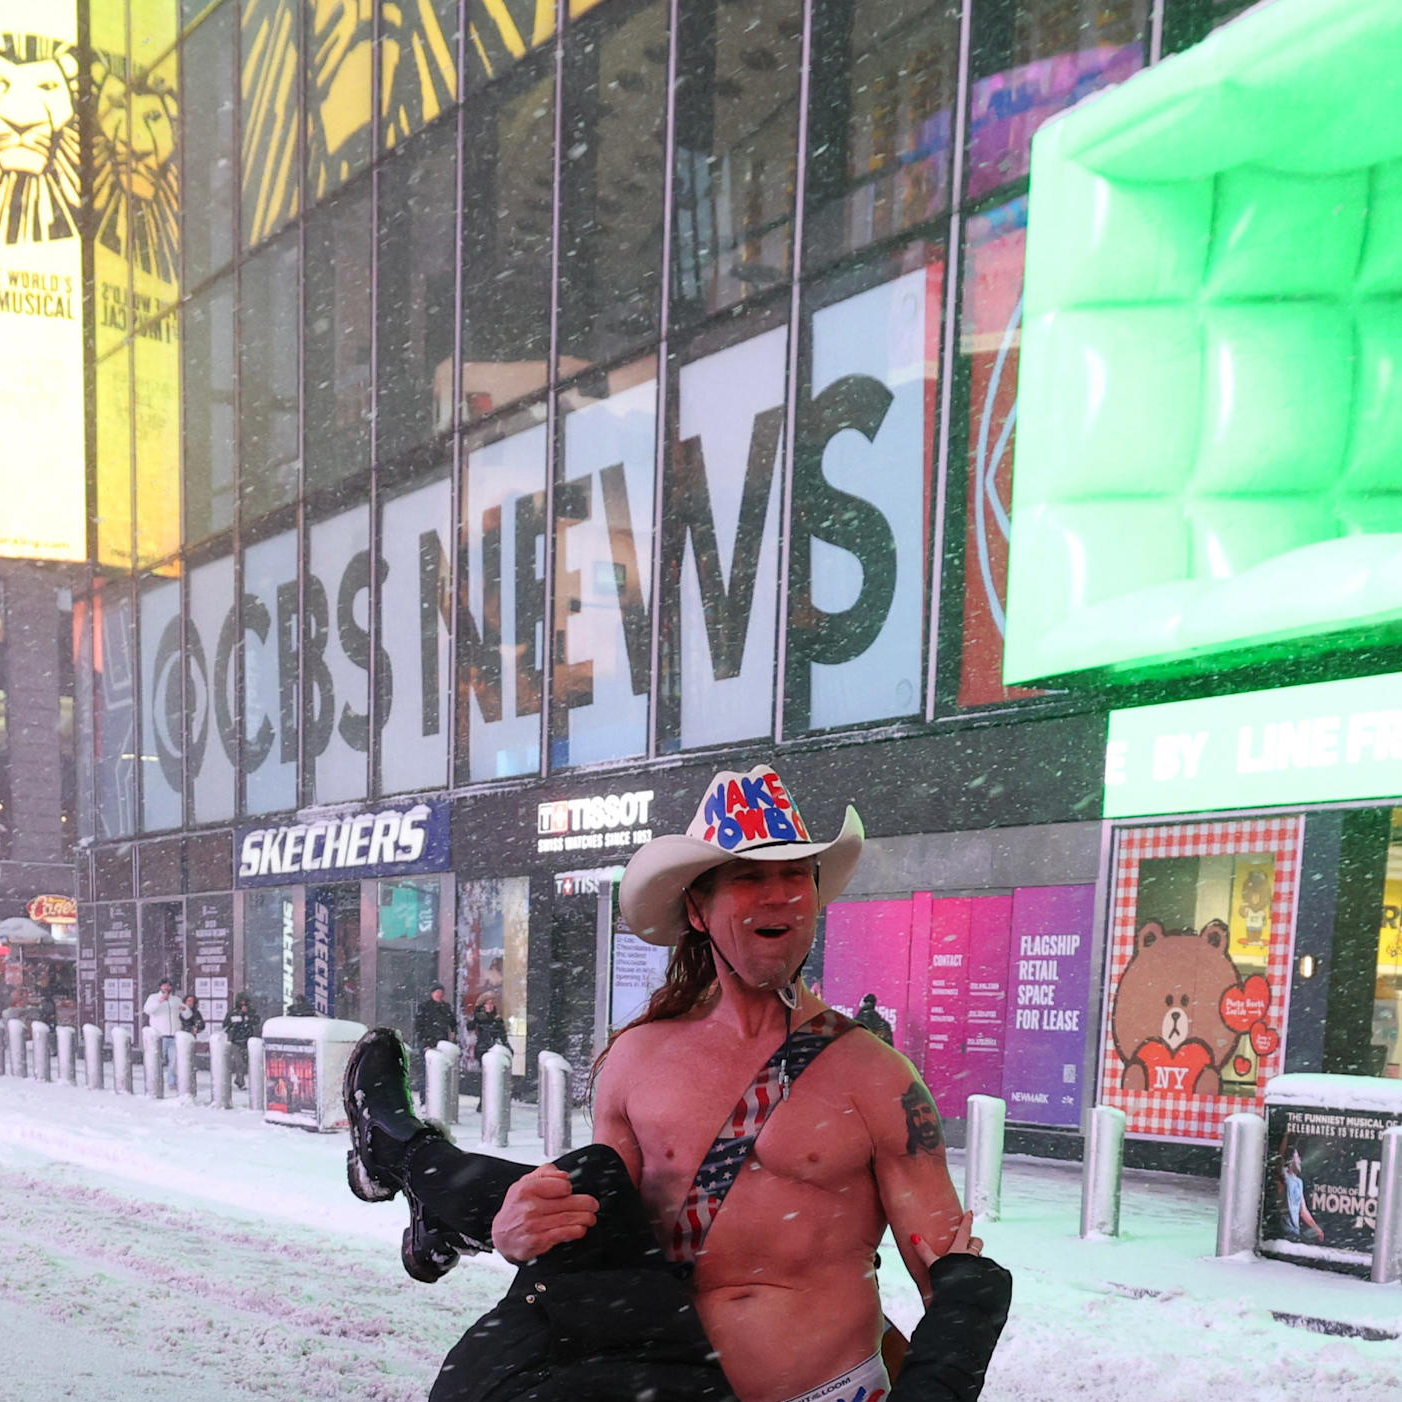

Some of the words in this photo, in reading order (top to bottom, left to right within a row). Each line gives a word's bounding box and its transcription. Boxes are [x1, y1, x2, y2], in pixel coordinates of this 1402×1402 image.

[8, 270, 72, 294] WORLD'S
[215, 550, 392, 775] CBS
[420, 373, 898, 738] NEWS
[1152, 730, 1209, 783] BY
[1235, 715, 1342, 775] LINE
[704, 772, 800, 826] NAKE
[569, 791, 654, 831] TISSOT
[239, 806, 432, 878] SKECHERS
[538, 836, 564, 853] SWISS
[605, 831, 631, 847] SINCE
[1020, 934, 1081, 956] FLAGSHIP
[283, 900, 295, 1017] SKECHE
[315, 901, 330, 1017] SKECHE
[933, 954, 963, 967] CONTACT
[1018, 960, 1059, 981] RETAIL
[1017, 984, 1056, 1006] SPACE
[1015, 1009, 1040, 1030] FOR
[1042, 1009, 1080, 1032] LEASE
[1154, 1066, 1189, 1090] NY
[1011, 1091, 1049, 1104] NEWMARK
[1287, 1123, 1335, 1137] CELEBRATES
[1338, 1125, 1347, 1137] 15
[1348, 1127, 1375, 1139] YEARS
[1304, 1113, 1345, 1126] FUNNIEST
[1346, 1117, 1384, 1129] MUSICAL
[1314, 1184, 1327, 1193] THE
[1328, 1185, 1348, 1195] BOOK
[1311, 1193, 1379, 1216] MORMO
[822, 1377, 851, 1396] LOOM
